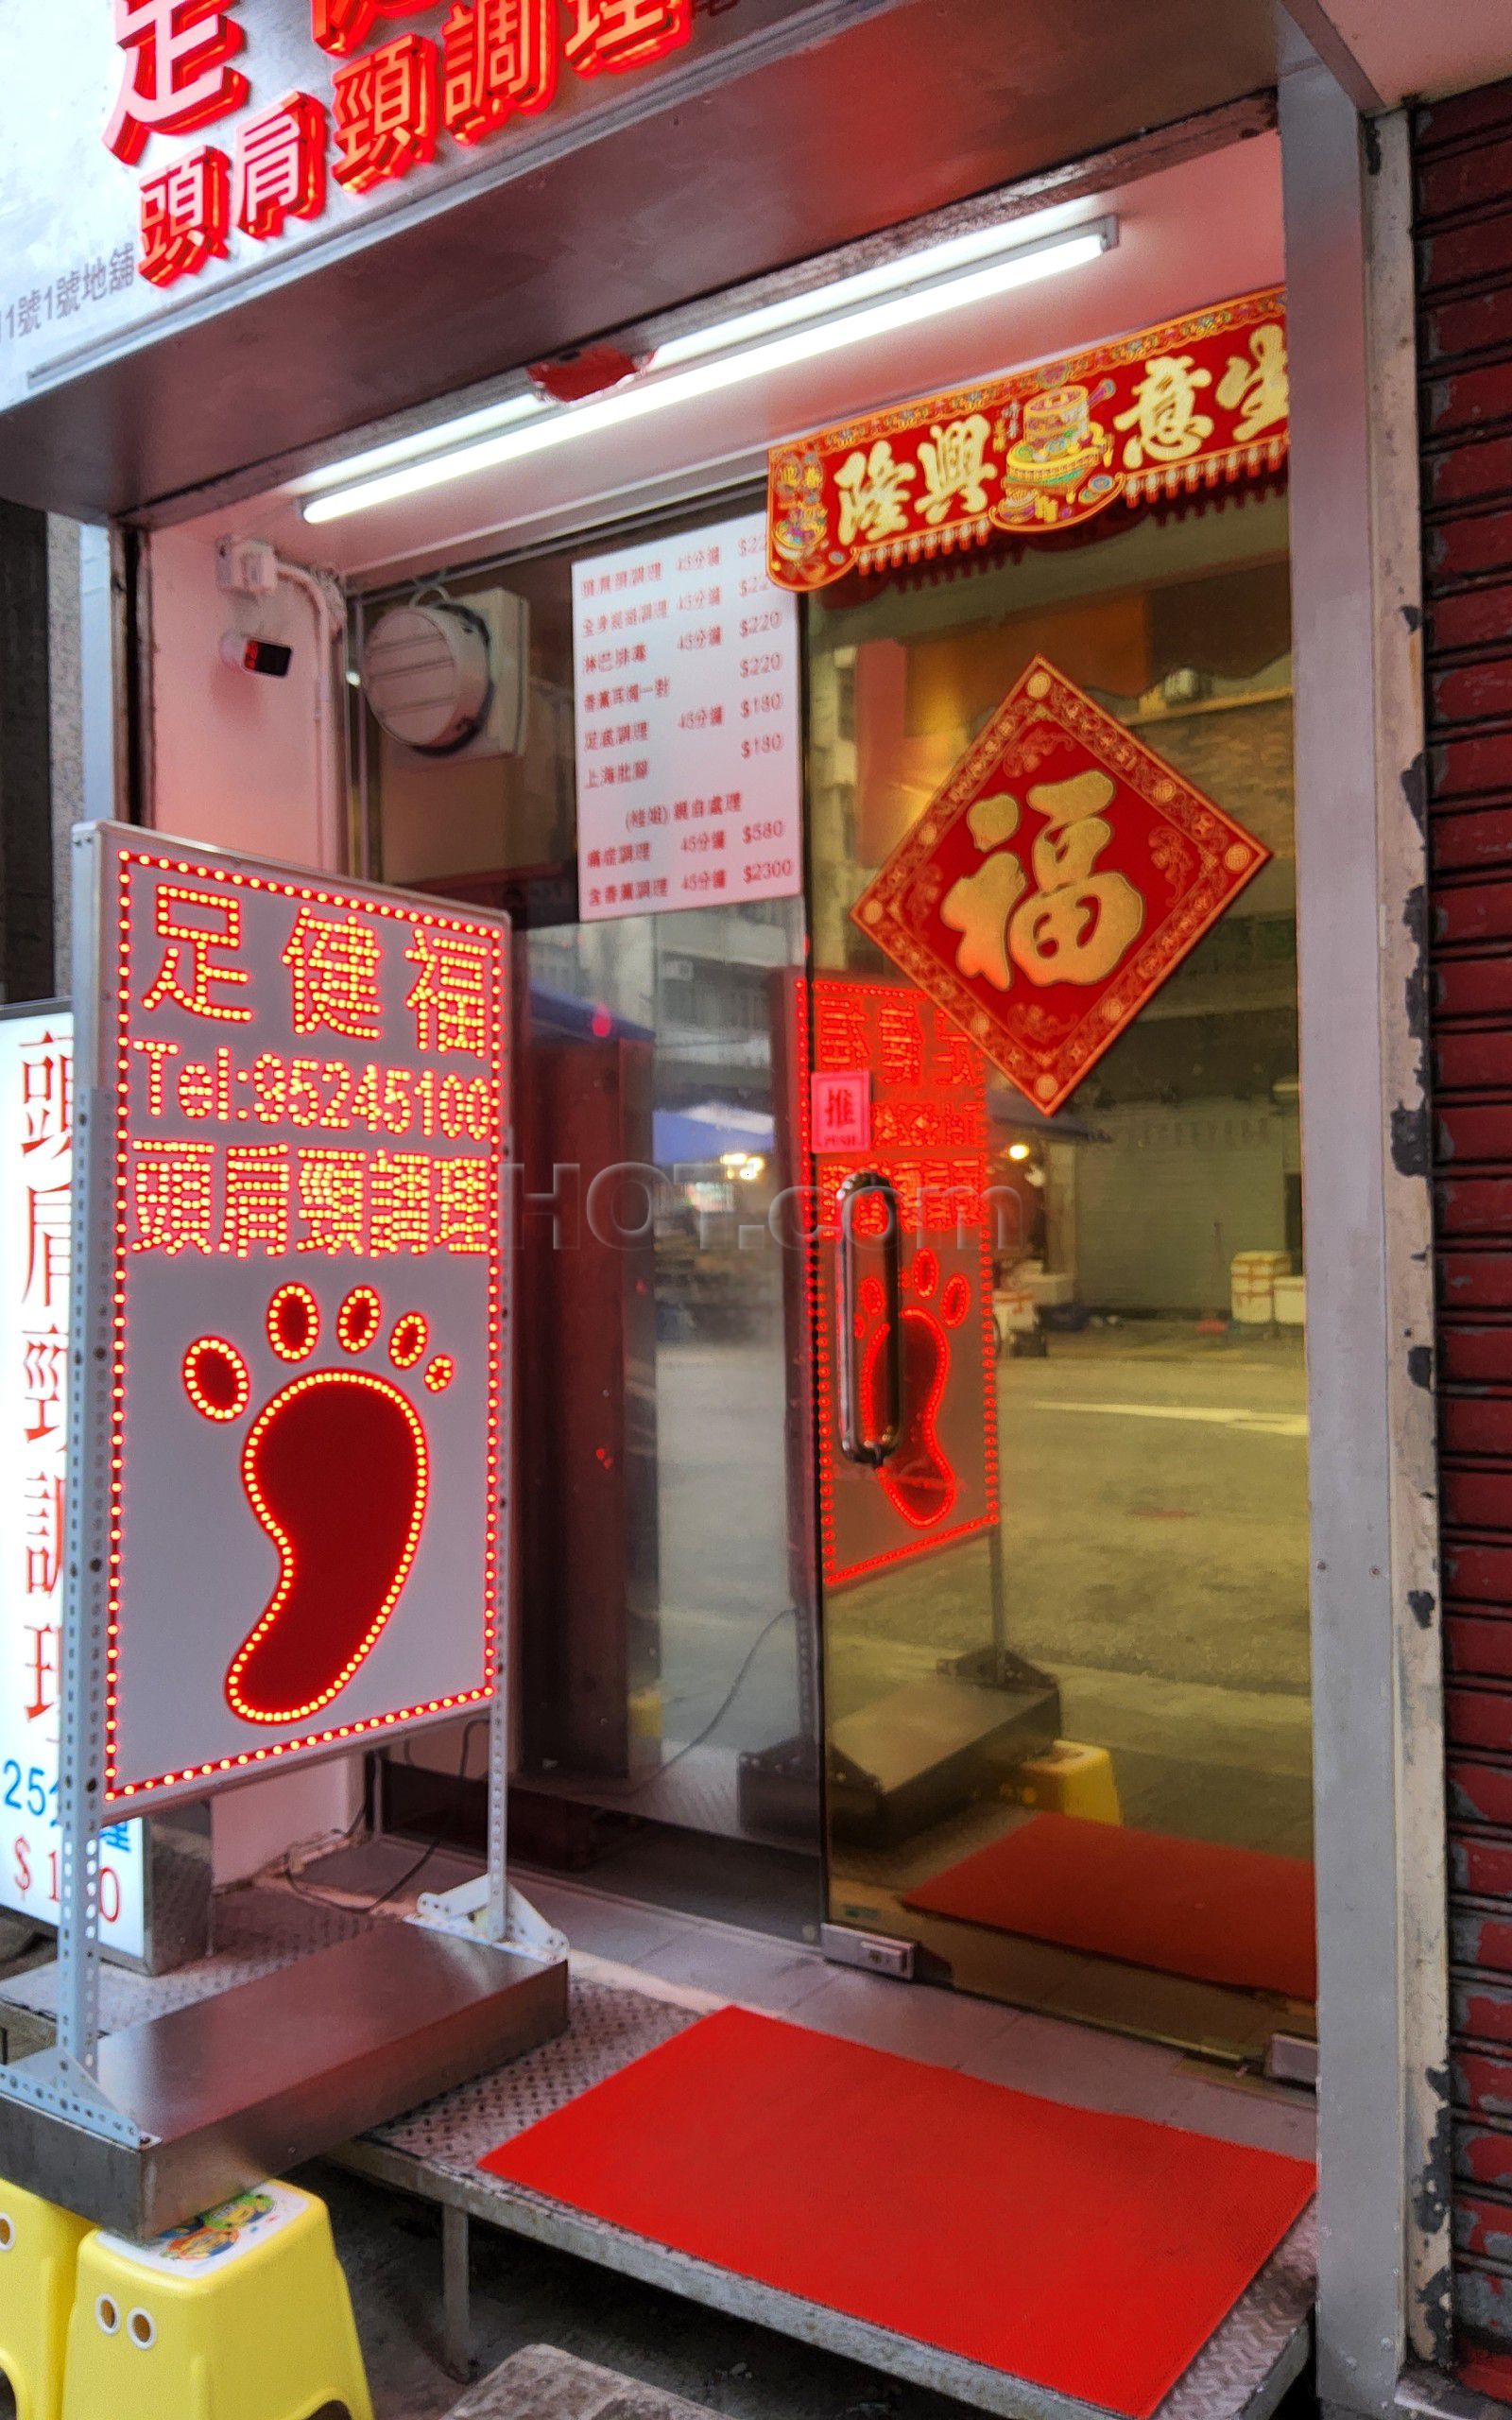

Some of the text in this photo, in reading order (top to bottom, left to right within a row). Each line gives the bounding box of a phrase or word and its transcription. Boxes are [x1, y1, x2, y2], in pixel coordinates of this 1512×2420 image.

[738, 536, 766, 558] $22
[739, 612, 782, 638] $220
[740, 652, 782, 679] $220
[743, 820, 785, 844] $580
[939, 769, 1146, 991] 福
[142, 884, 490, 1056] 足健福
[130, 1040, 491, 1141] Tel:95245100
[130, 1139, 490, 1257] 頭肩頸調理
[14, 1834, 121, 1923] $10
